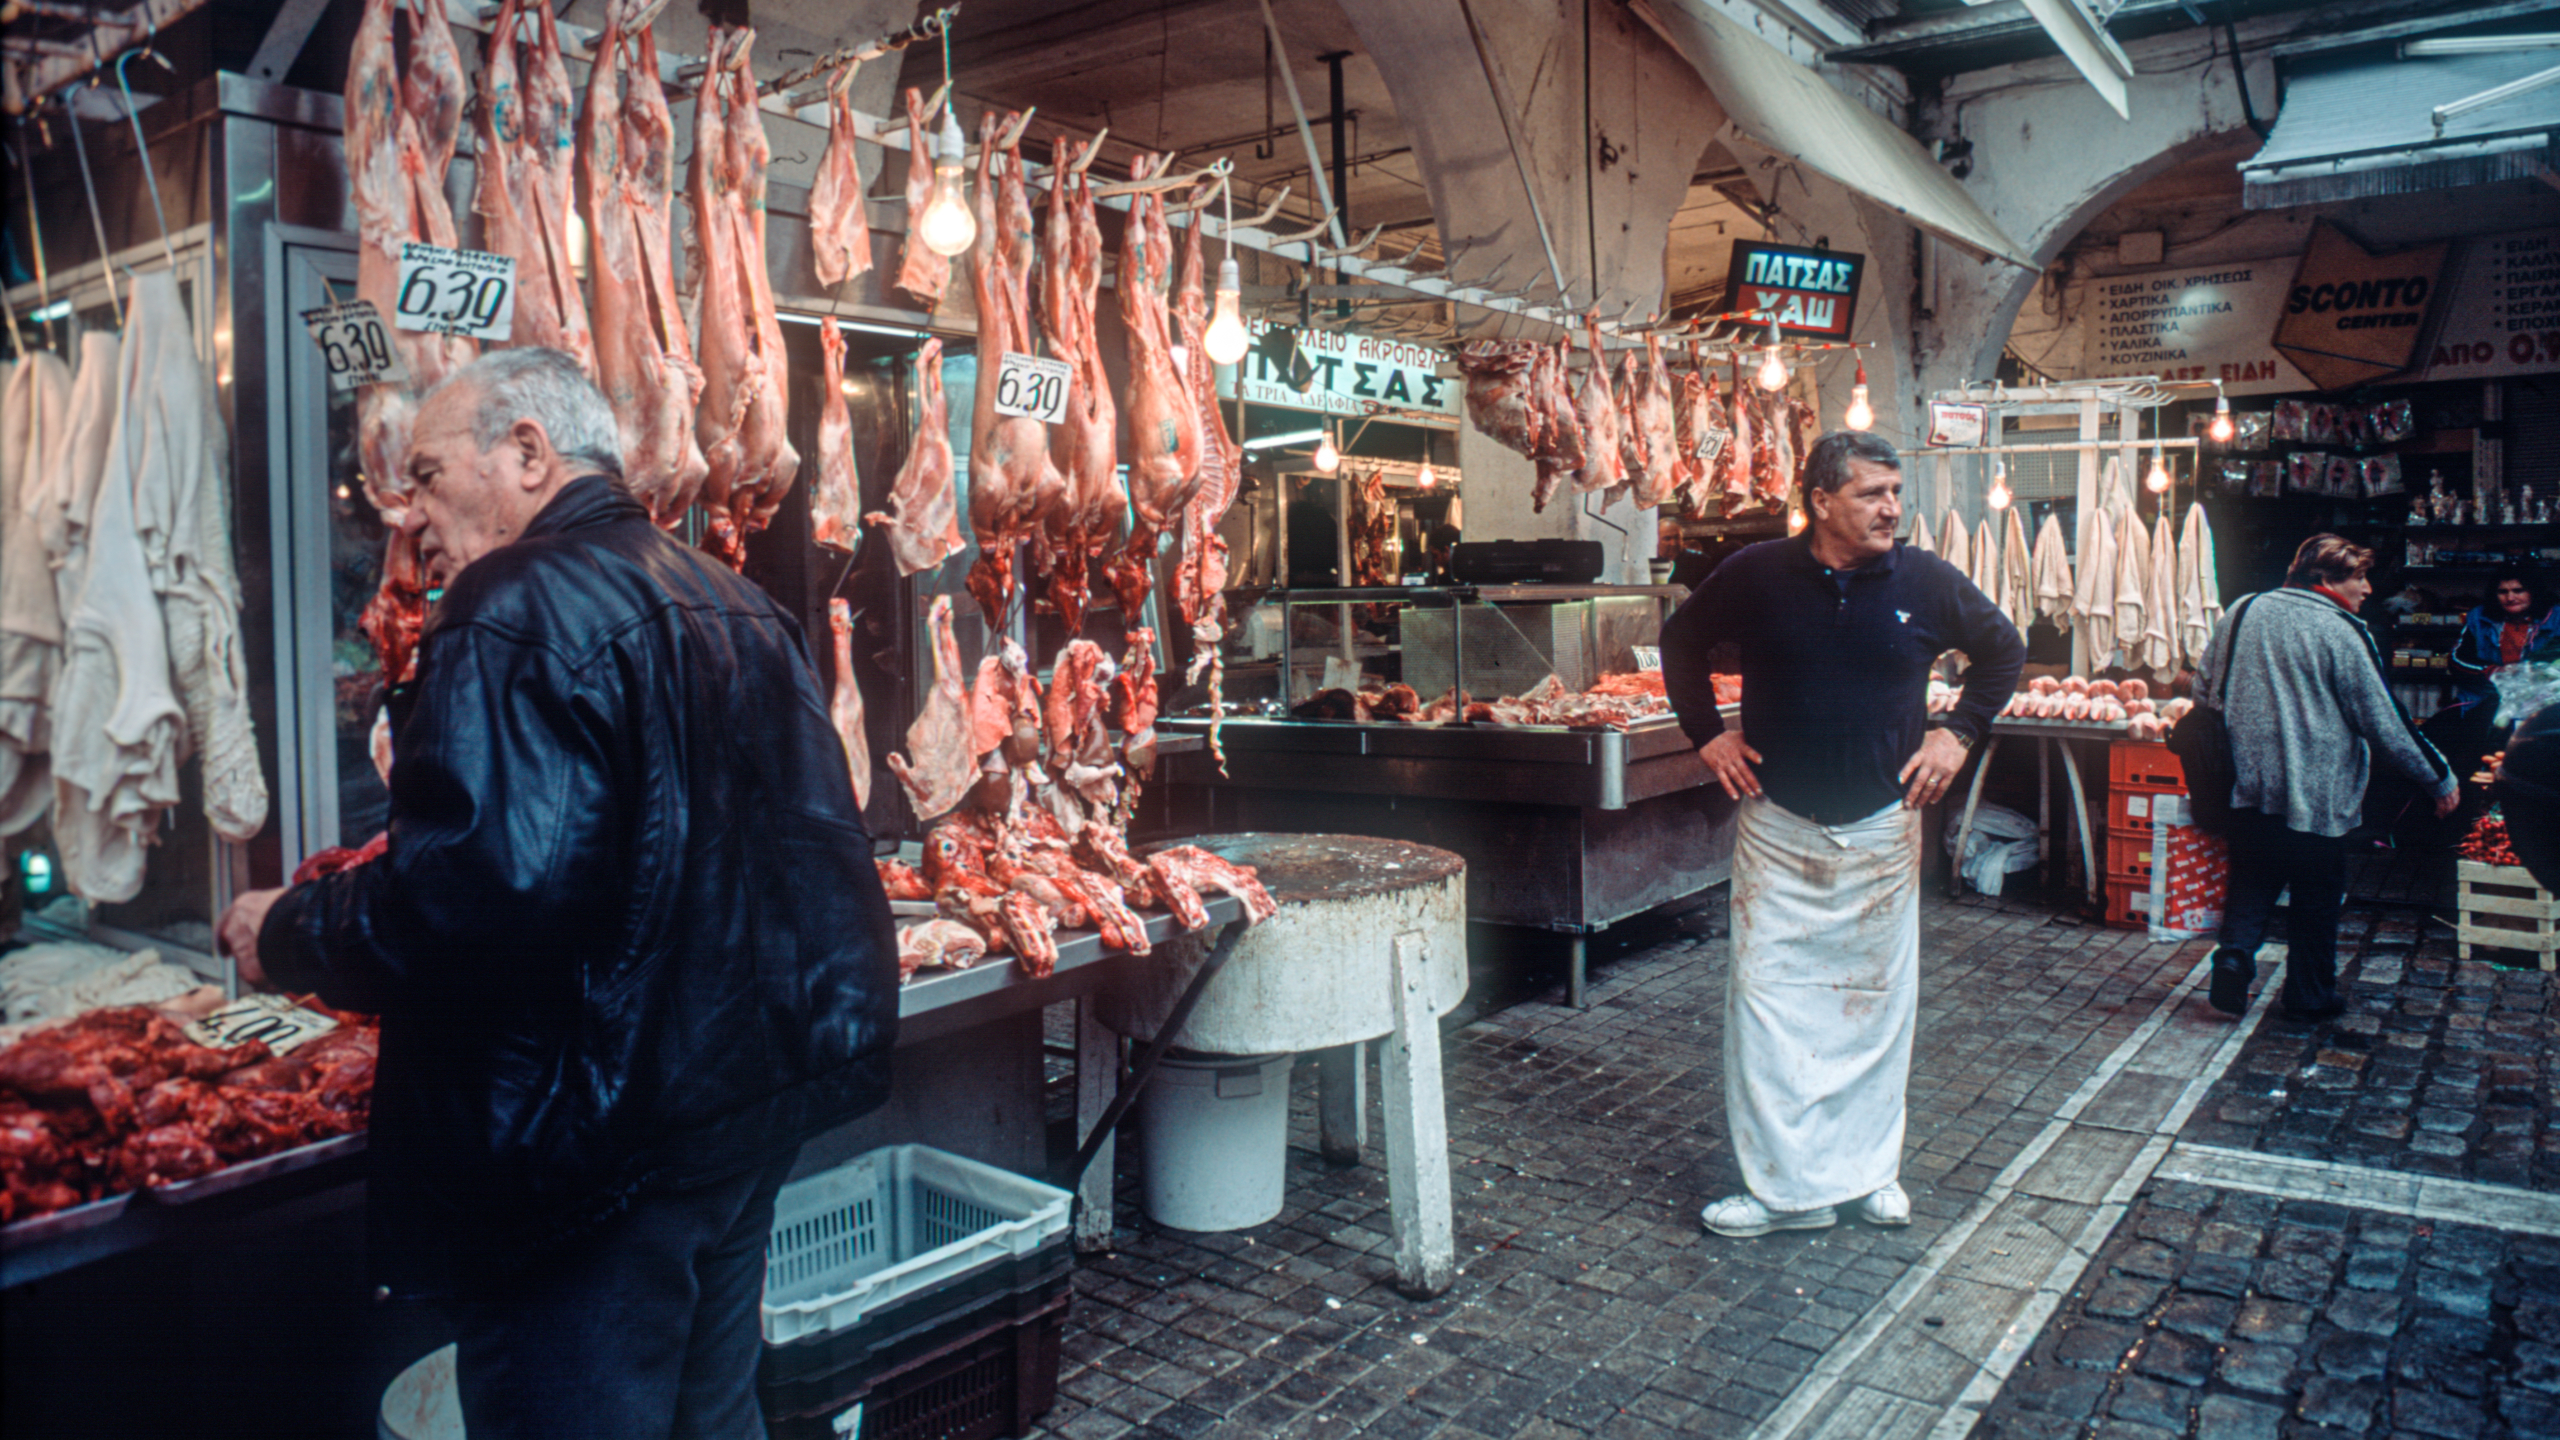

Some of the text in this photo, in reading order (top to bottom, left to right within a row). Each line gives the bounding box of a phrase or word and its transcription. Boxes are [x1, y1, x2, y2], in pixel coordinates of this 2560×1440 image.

[1745, 252, 1854, 293] ΠΑΤΣΑΣ
[2109, 269, 2253, 296] ΕΙΔΗ ΟΙΚ. ΧΡΗΣΕΩΣ
[2109, 294, 2171, 310] ΧΑΡΤΙΚΑ
[2288, 276, 2429, 314] SCONTO
[2110, 301, 2233, 323] ΑΠΟΡΡΥΠΑΝΤΙΚΑ
[2336, 312, 2419, 330] CENTER
[2110, 321, 2180, 337] ΠΛΑΣΤΙΚΑ
[2110, 337, 2162, 351] ΥΑΛΙΚΑ
[2430, 341, 2495, 367] ΑΠΟ
[2110, 349, 2187, 365] ΚΟΥΖΙΝΙΚΑ
[2220, 360, 2276, 383] ΕΙΔΗ
[1255, 385, 1288, 404] ΤΡΙΑ
